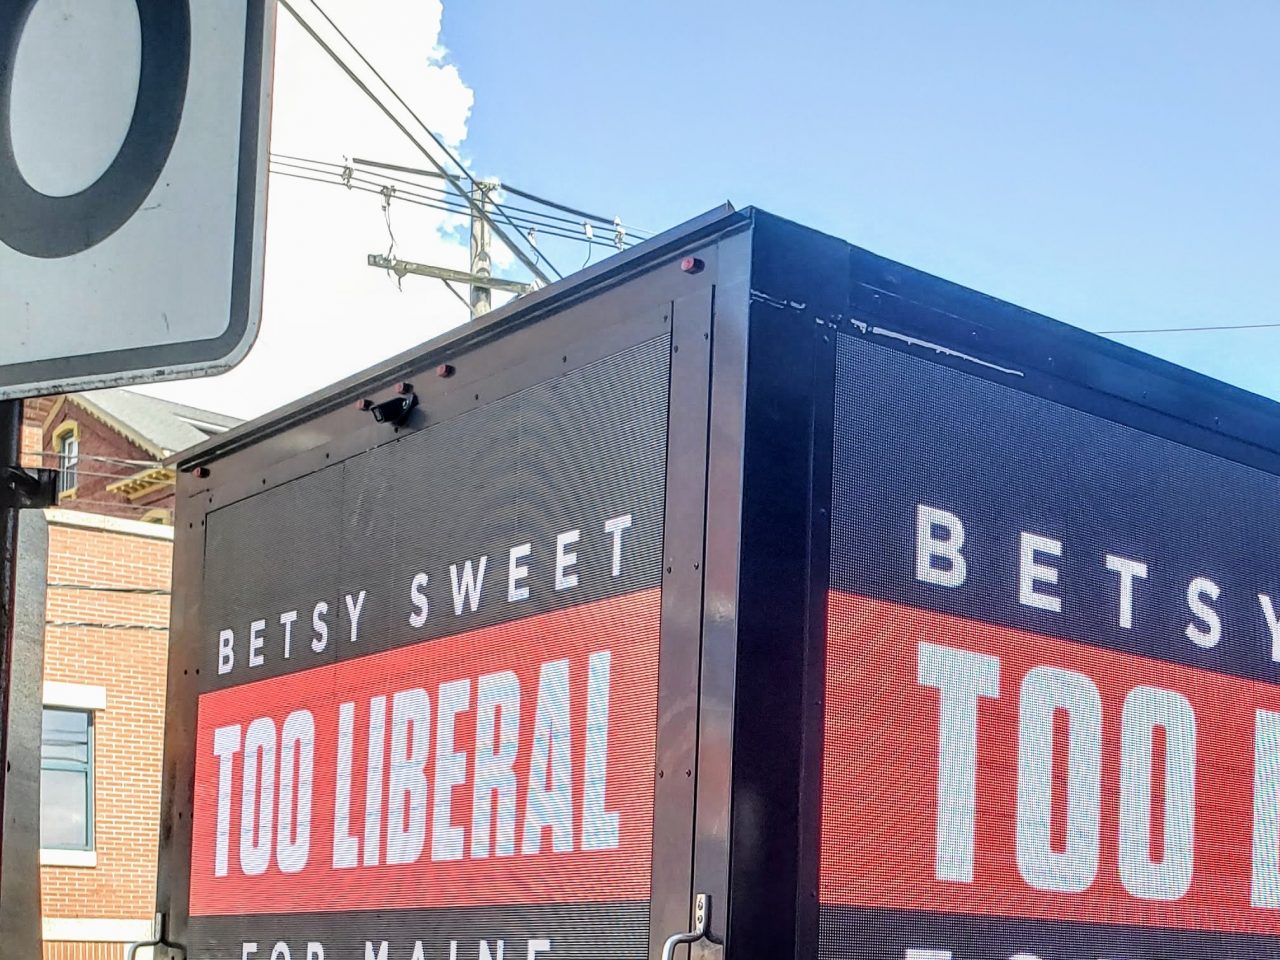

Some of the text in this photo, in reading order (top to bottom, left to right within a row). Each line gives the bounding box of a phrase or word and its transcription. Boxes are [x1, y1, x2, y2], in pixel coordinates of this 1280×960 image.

[217, 515, 633, 675] BETSY SWEET
[213, 650, 621, 877] TOO LIBERAL
[916, 641, 1198, 902] TOO
